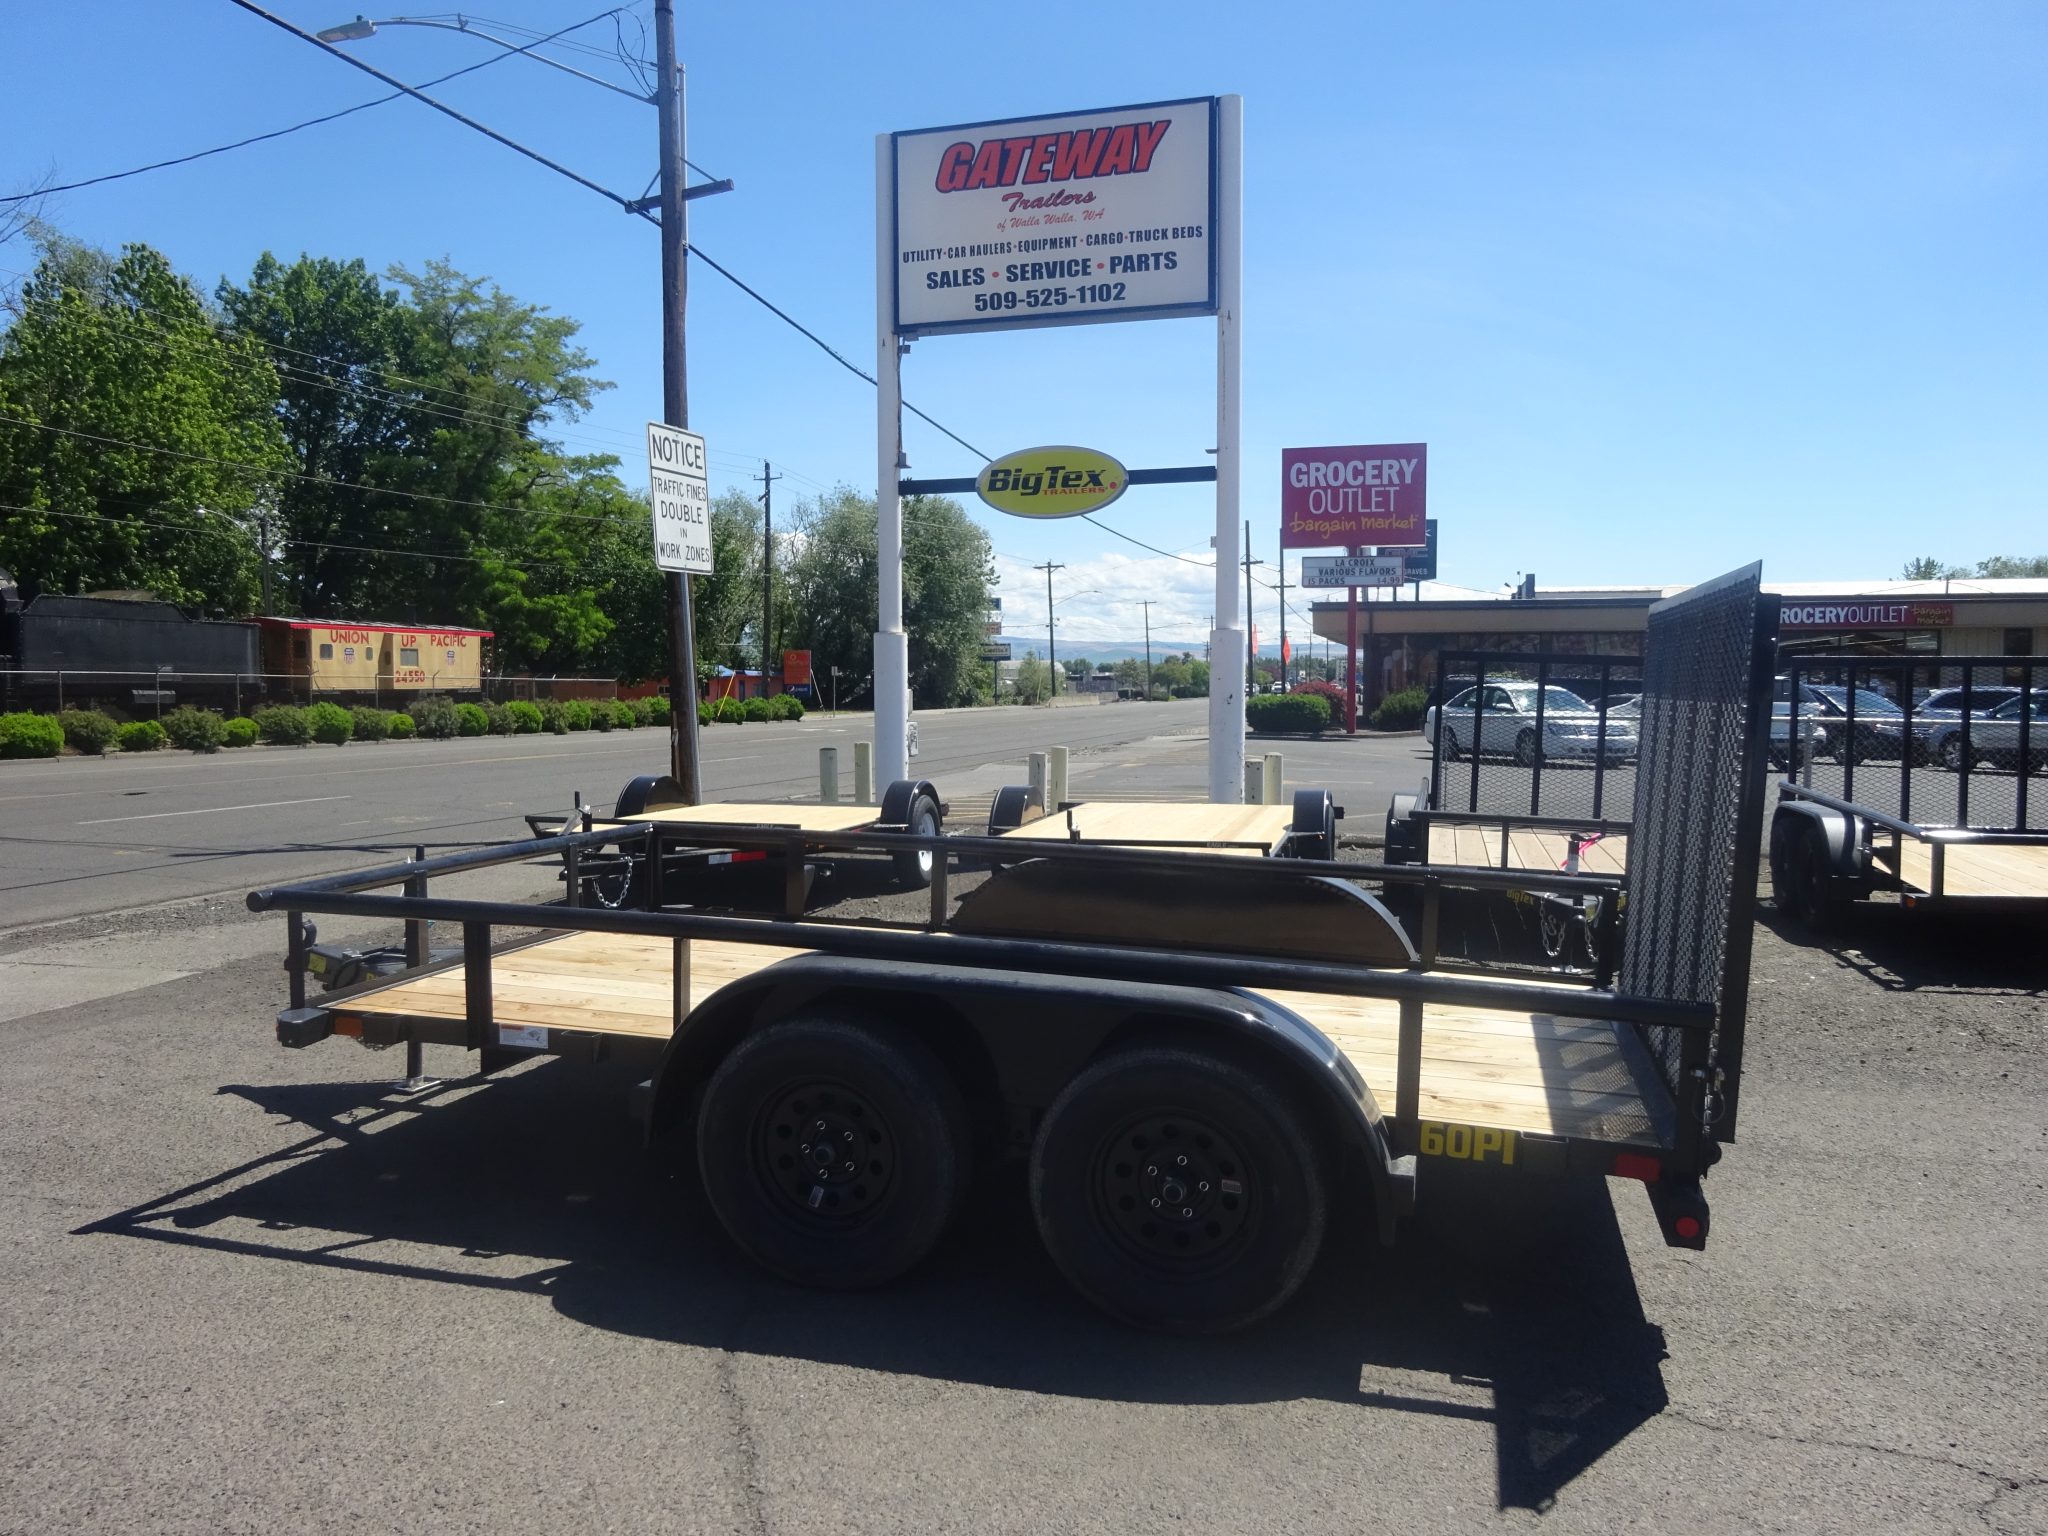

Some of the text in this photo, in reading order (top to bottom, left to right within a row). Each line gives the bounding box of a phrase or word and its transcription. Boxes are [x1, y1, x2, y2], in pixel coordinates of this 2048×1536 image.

[935, 119, 1172, 194] GATEWAY
[1001, 189, 1097, 212] Trailers
[997, 219, 1006, 232] of
[1010, 217, 1040, 228] Walla
[1082, 208, 1105, 221] WA
[902, 225, 1203, 264] UTILITY CAR HAULERS EQUIPMENT CARGO TRUCK BEDS
[926, 251, 1178, 290] SALES SERVICE PARTS
[975, 281, 1126, 312] 509-525-1102
[652, 433, 703, 470] NOTICE
[1289, 458, 1418, 488] GROCERY
[653, 476, 706, 502] TRAFFIC FINES
[1042, 486, 1105, 496] TRAILERS
[1308, 486, 1400, 515] OUTLET
[660, 500, 703, 525] DOUBLE
[680, 527, 687, 539] IN
[1289, 511, 1417, 539] bargain market
[659, 541, 710, 563] WORK ZONES
[1335, 558, 1375, 567] LA CROIX
[1318, 567, 1396, 577] VARIOUS FLAVORS
[1319, 577, 1345, 585] PACKS
[330, 630, 467, 648] UNION UP PACIFIC
[395, 670, 425, 684] 24550
